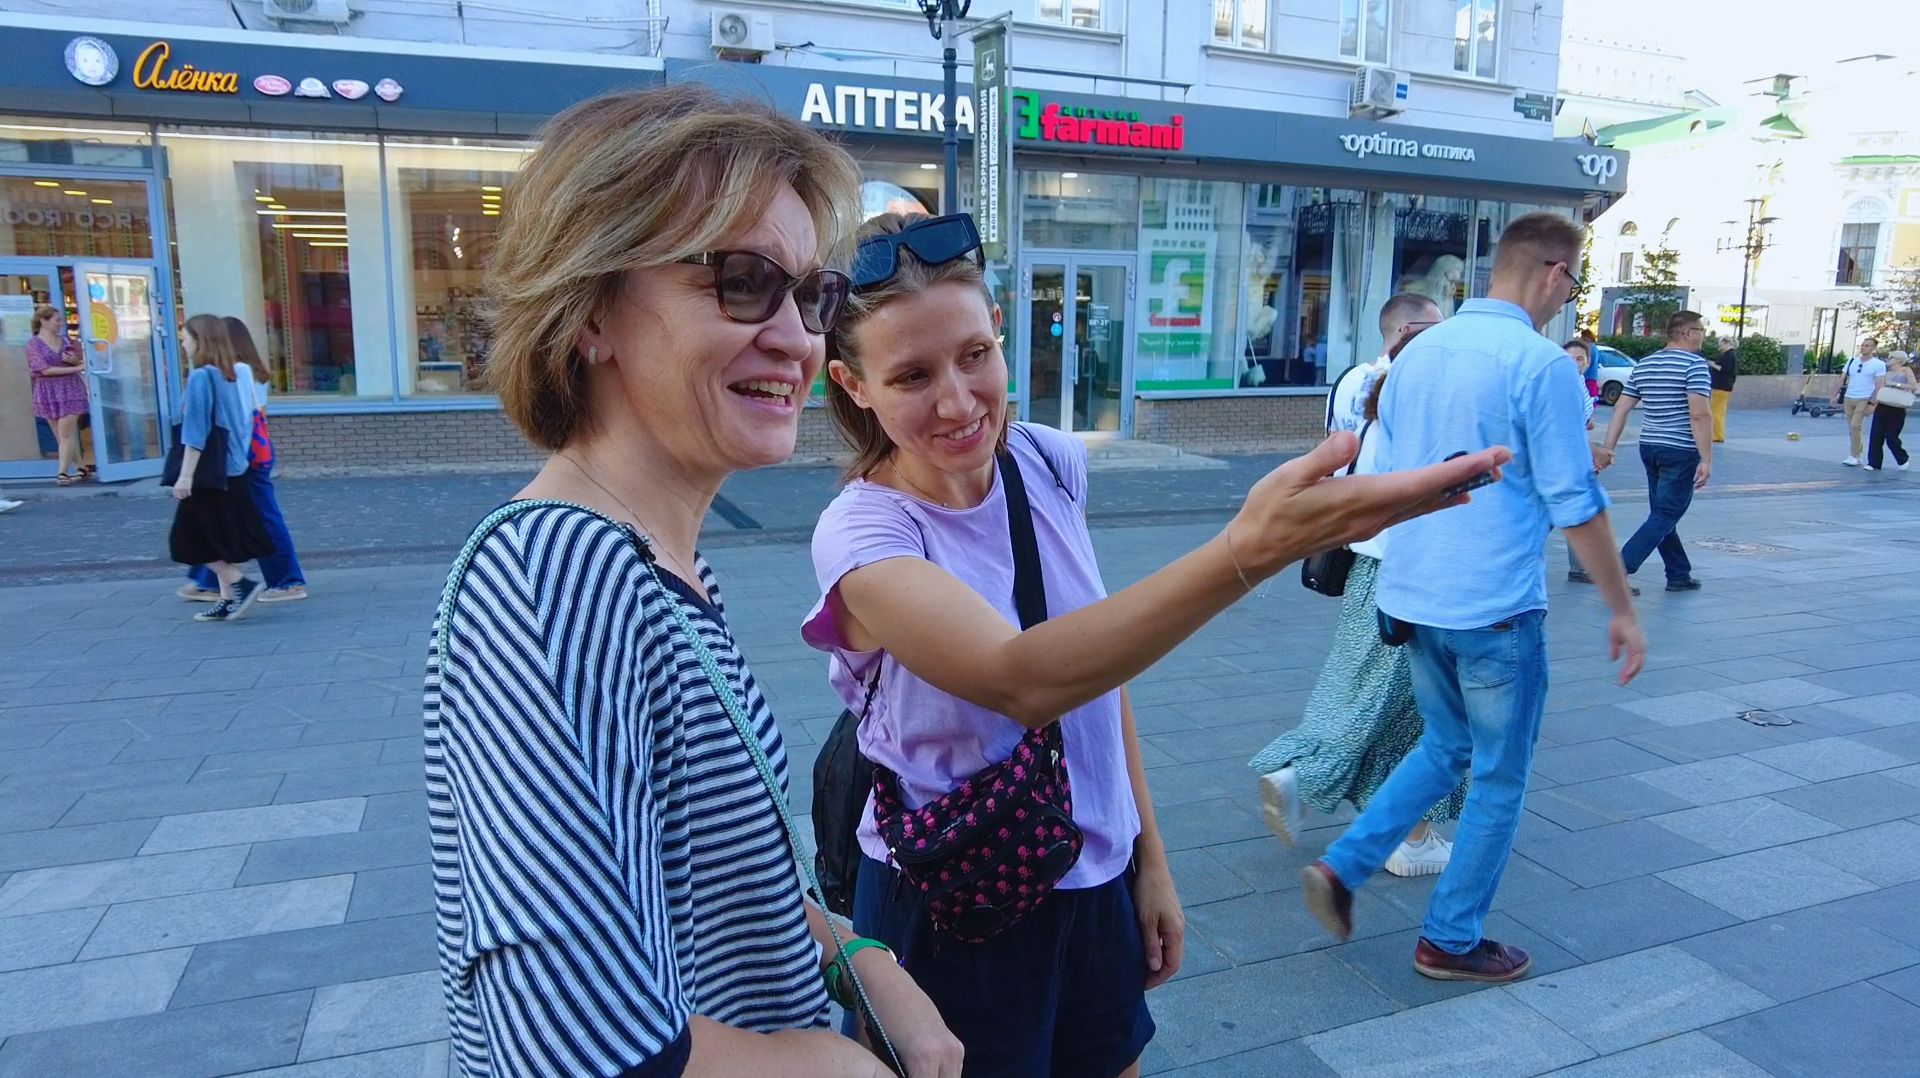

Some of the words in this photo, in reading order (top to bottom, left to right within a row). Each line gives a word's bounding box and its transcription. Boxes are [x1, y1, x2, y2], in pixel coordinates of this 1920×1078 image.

[133, 41, 239, 92] Алёнка
[800, 83, 975, 134] АПТЕКА
[1040, 103, 1184, 149] farmani
[1062, 105, 1142, 122] аптеки
[980, 89, 988, 196] ФОРМИРОВАНИЯ
[1340, 131, 1418, 159] optima
[980, 199, 988, 243] НОВЫЕ
